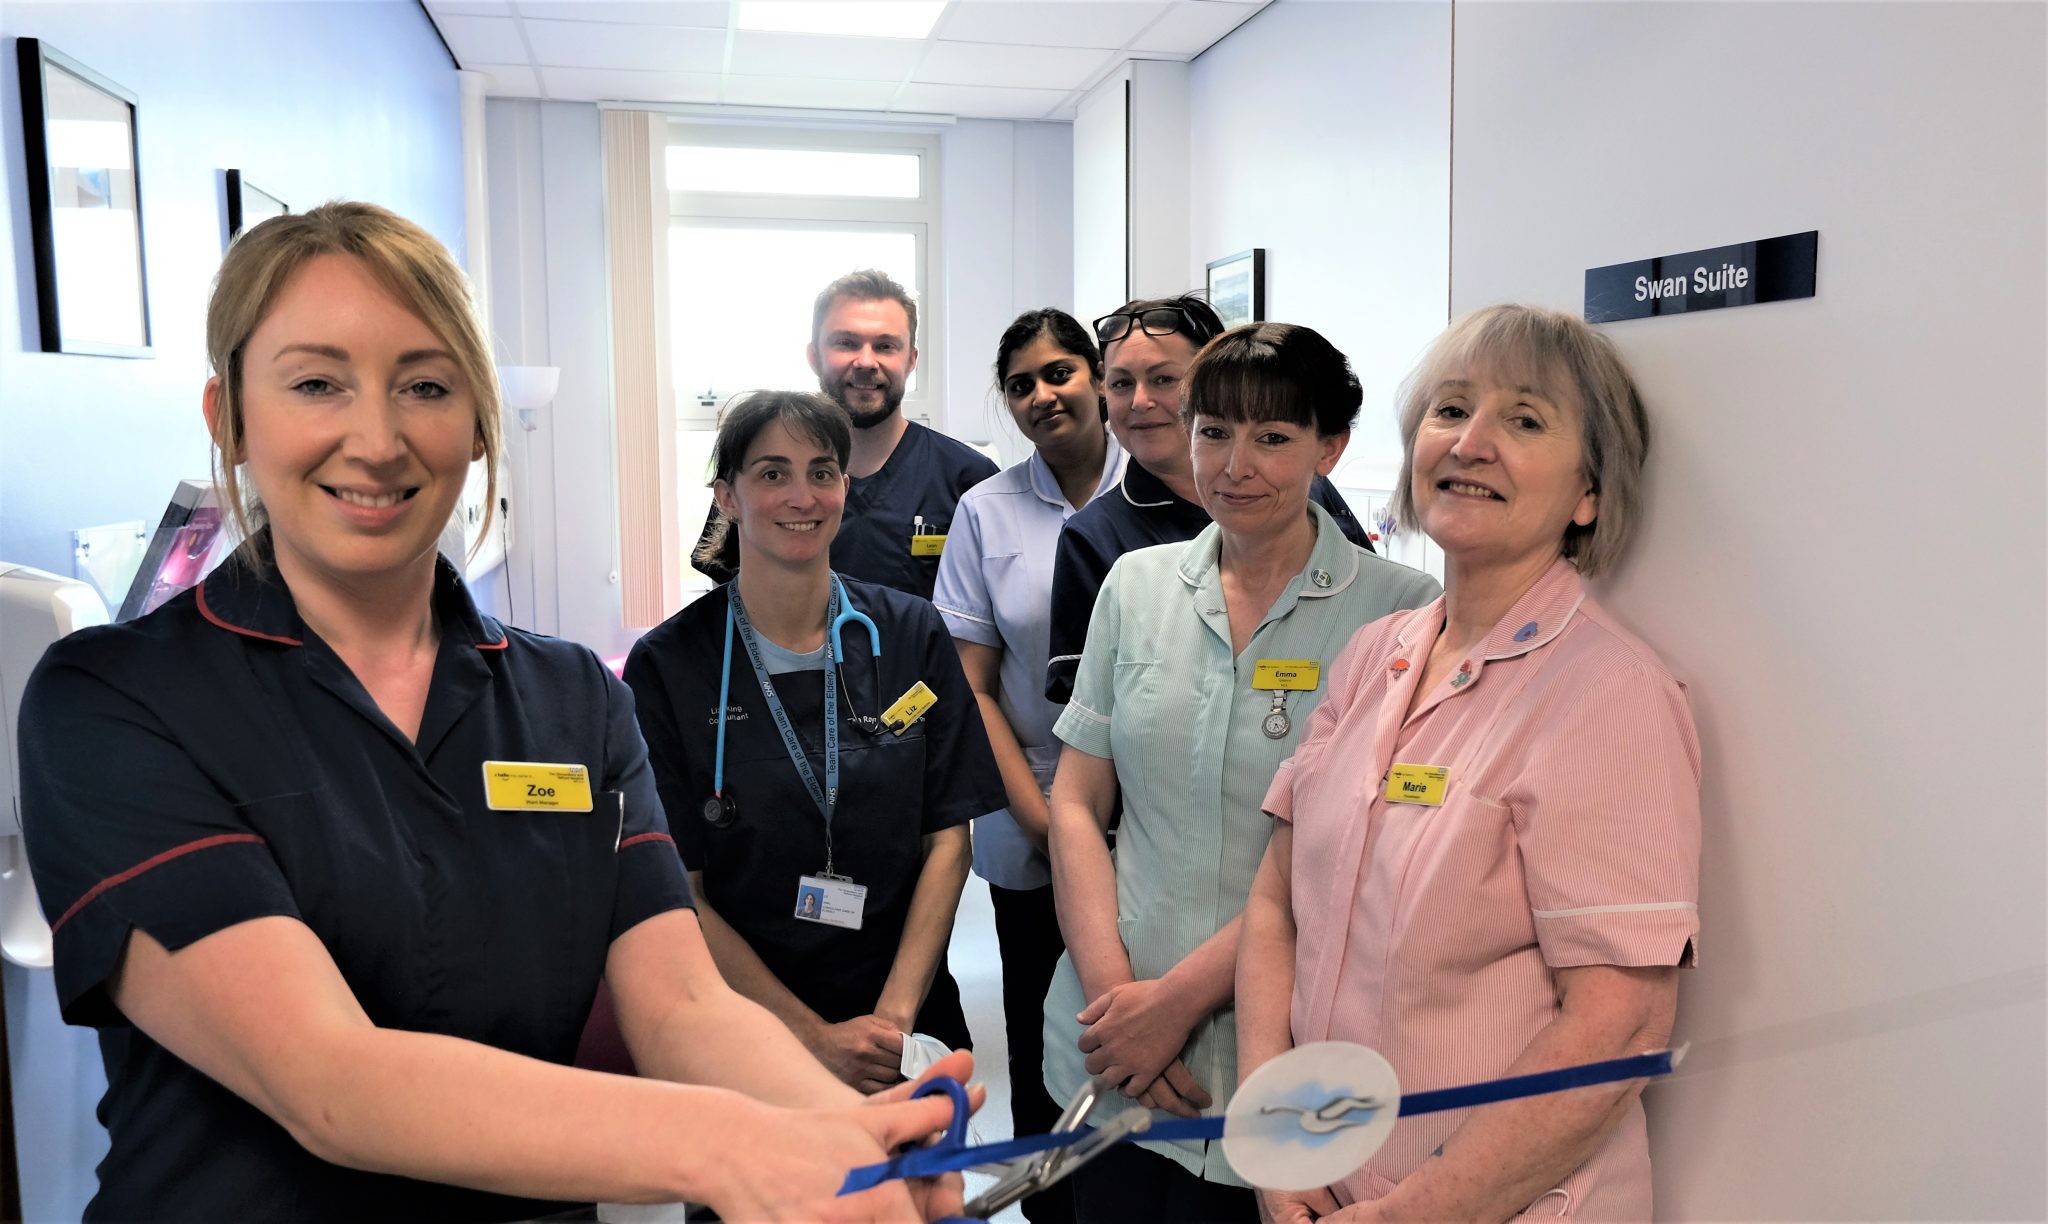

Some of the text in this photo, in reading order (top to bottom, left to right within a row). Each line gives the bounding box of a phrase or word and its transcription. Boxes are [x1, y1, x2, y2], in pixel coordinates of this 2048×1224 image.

[1634, 263, 1749, 302] Swan Suite
[732, 595, 744, 616] Care
[740, 617, 749, 627] of
[743, 626, 753, 641] the
[748, 642, 764, 671] Elderly
[762, 681, 775, 699] NHS
[905, 705, 918, 716] Liz
[826, 670, 836, 775] Team Care of the Elderly
[774, 706, 825, 804] Team Care of the Elderly
[526, 784, 556, 797] Zoe
[1402, 781, 1427, 793] Marie
[828, 787, 837, 806] NHS
